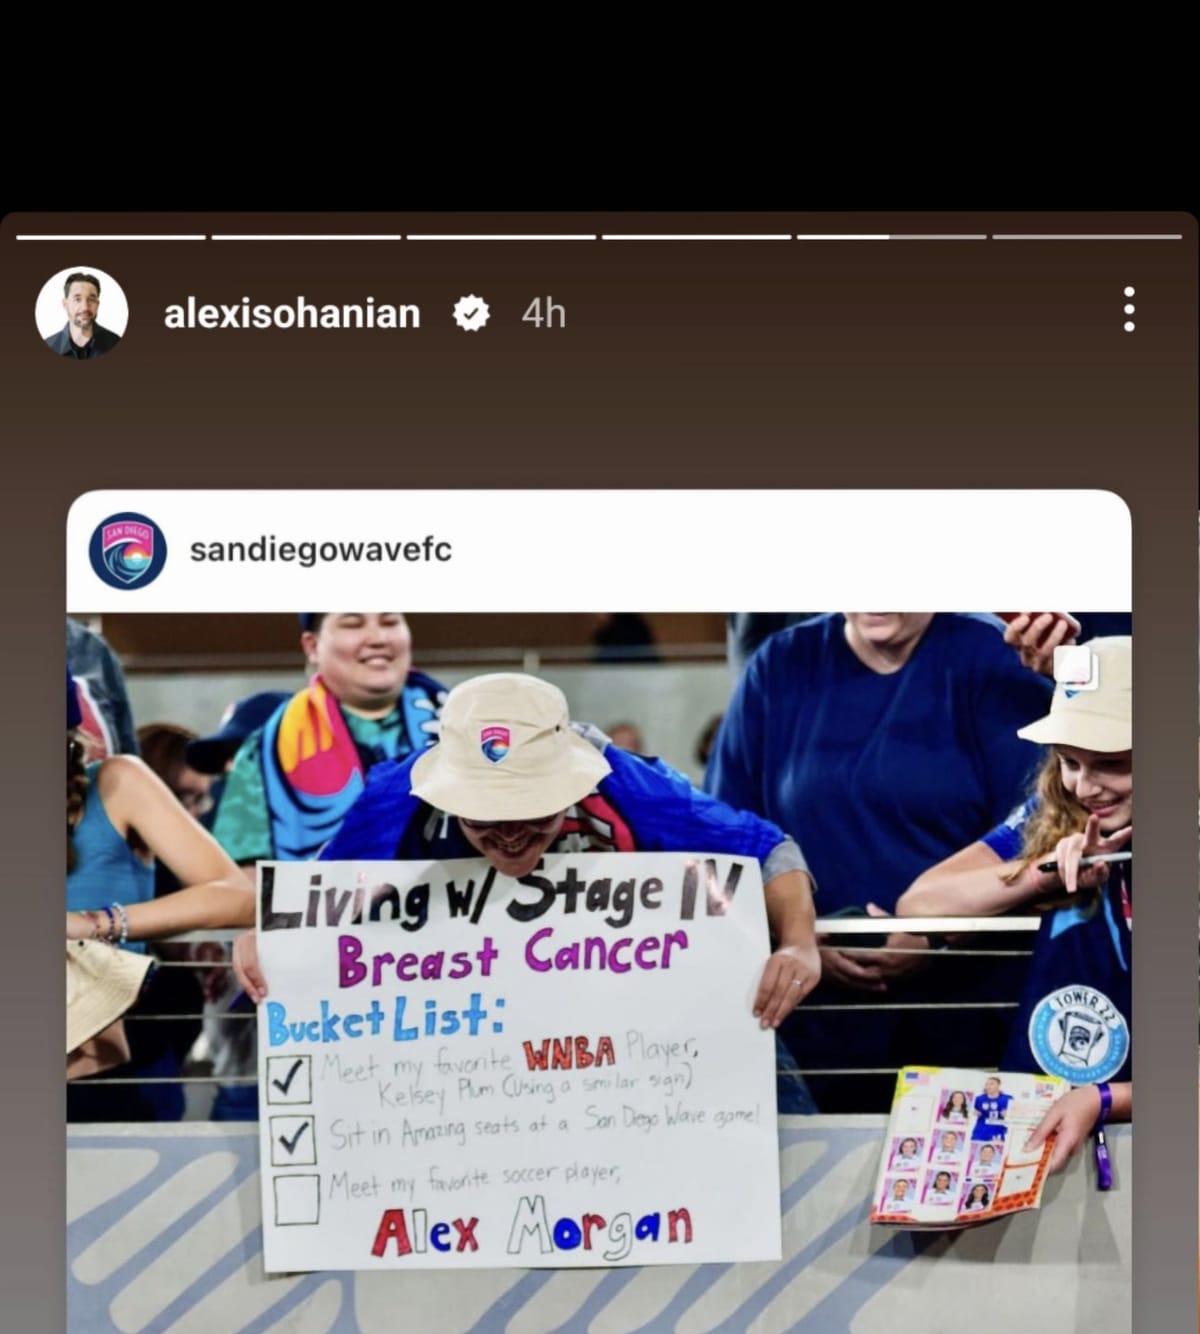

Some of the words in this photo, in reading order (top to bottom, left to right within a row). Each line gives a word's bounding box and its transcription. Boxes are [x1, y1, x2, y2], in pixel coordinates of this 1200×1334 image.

[261, 866, 430, 932] Living
[445, 866, 499, 925] w/
[506, 858, 663, 929] Stage
[680, 858, 744, 921] IV
[337, 934, 499, 988] Breast
[525, 927, 689, 974] Cancer
[266, 1000, 385, 1047] Bucket
[393, 993, 505, 1042] List:
[1055, 990, 1099, 1009] TOWER
[322, 1053, 381, 1083] Meet
[394, 1061, 423, 1085] my
[433, 1047, 512, 1075] favorite
[522, 1036, 616, 1071] WNBA
[378, 1082, 446, 1117] Kelsey
[457, 1077, 495, 1100] Plum
[560, 1080, 572, 1094] a
[648, 1062, 694, 1098] sign)
[329, 1118, 367, 1151] Sit
[372, 1125, 391, 1146] in
[401, 1118, 467, 1147] Amazing
[474, 1119, 520, 1135] seats
[528, 1114, 549, 1133] at
[557, 1119, 569, 1133] a
[584, 1104, 617, 1131] San
[664, 1101, 706, 1126] Wave
[328, 1172, 382, 1200] Meet
[391, 1177, 415, 1199] my
[428, 1165, 491, 1193] favorite
[502, 1166, 560, 1184] soccer
[371, 1208, 480, 1258] Alex
[506, 1194, 694, 1262] Morgan
